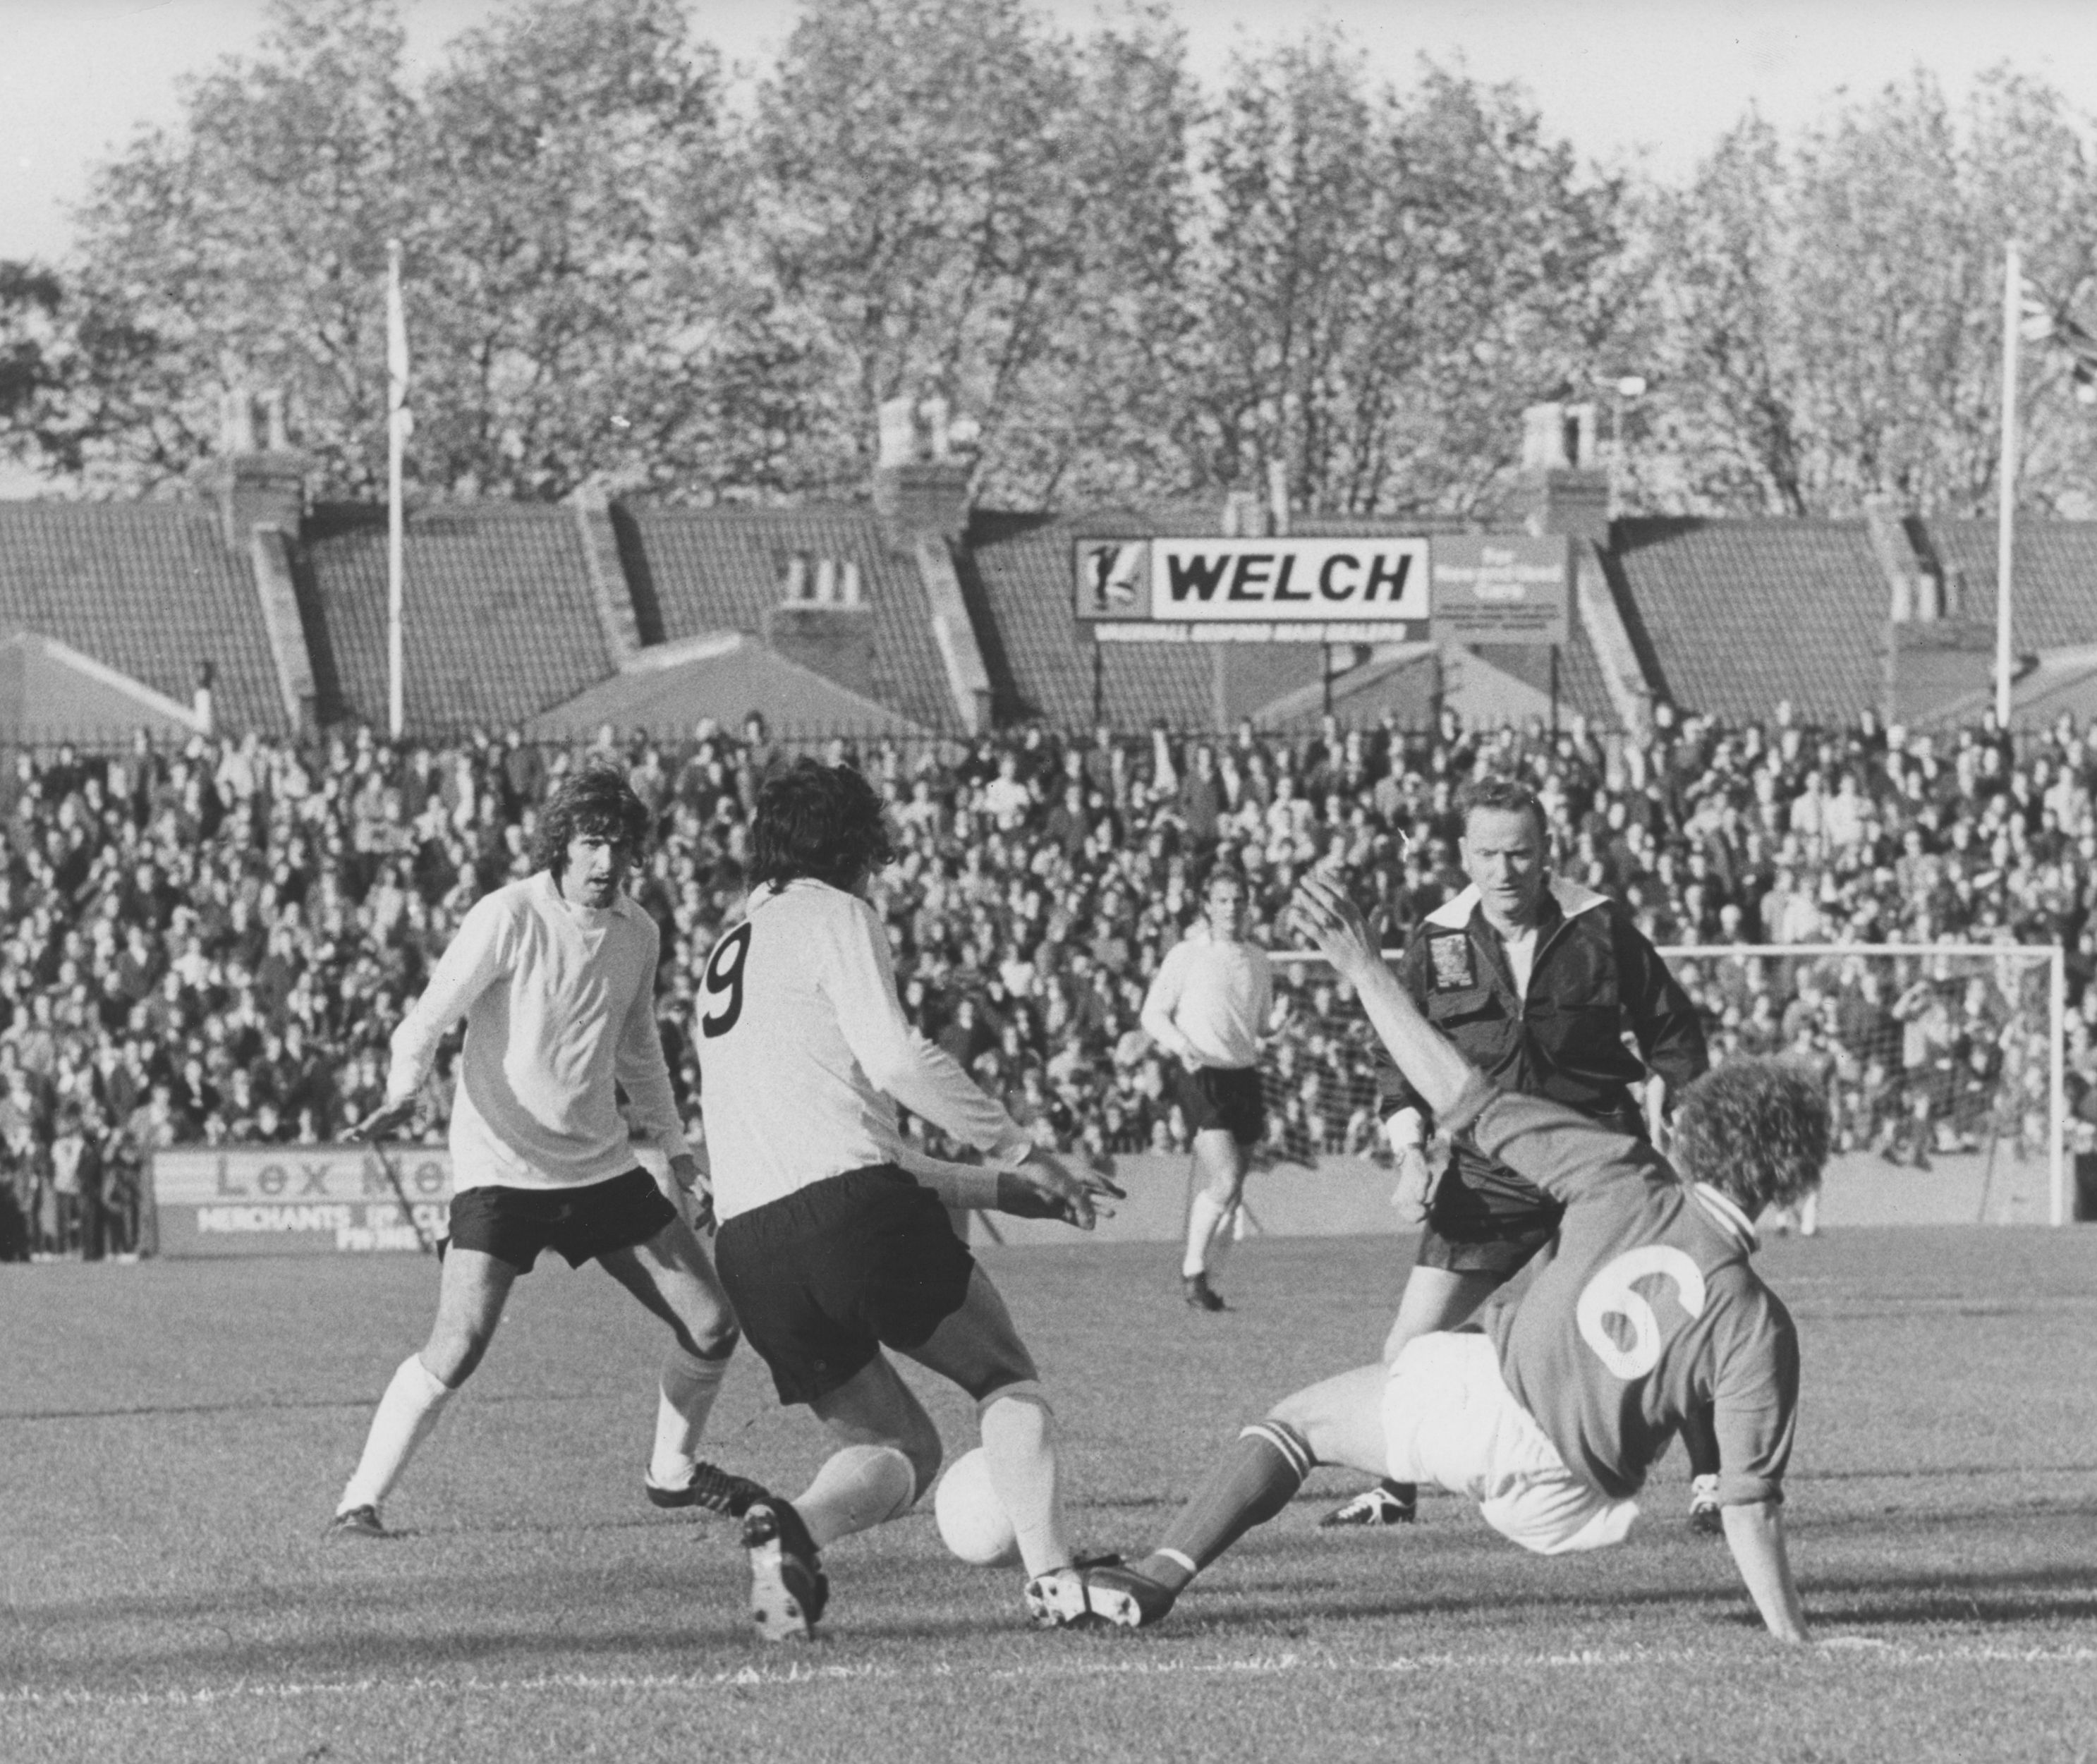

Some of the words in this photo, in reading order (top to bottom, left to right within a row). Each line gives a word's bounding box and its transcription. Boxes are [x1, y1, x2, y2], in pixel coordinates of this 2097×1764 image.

[1167, 554, 1411, 601] WELCH
[703, 922, 752, 1038] 9
[218, 1156, 330, 1196] Lex
[363, 1155, 445, 1195] Me
[1576, 1244, 1706, 1381] 6
